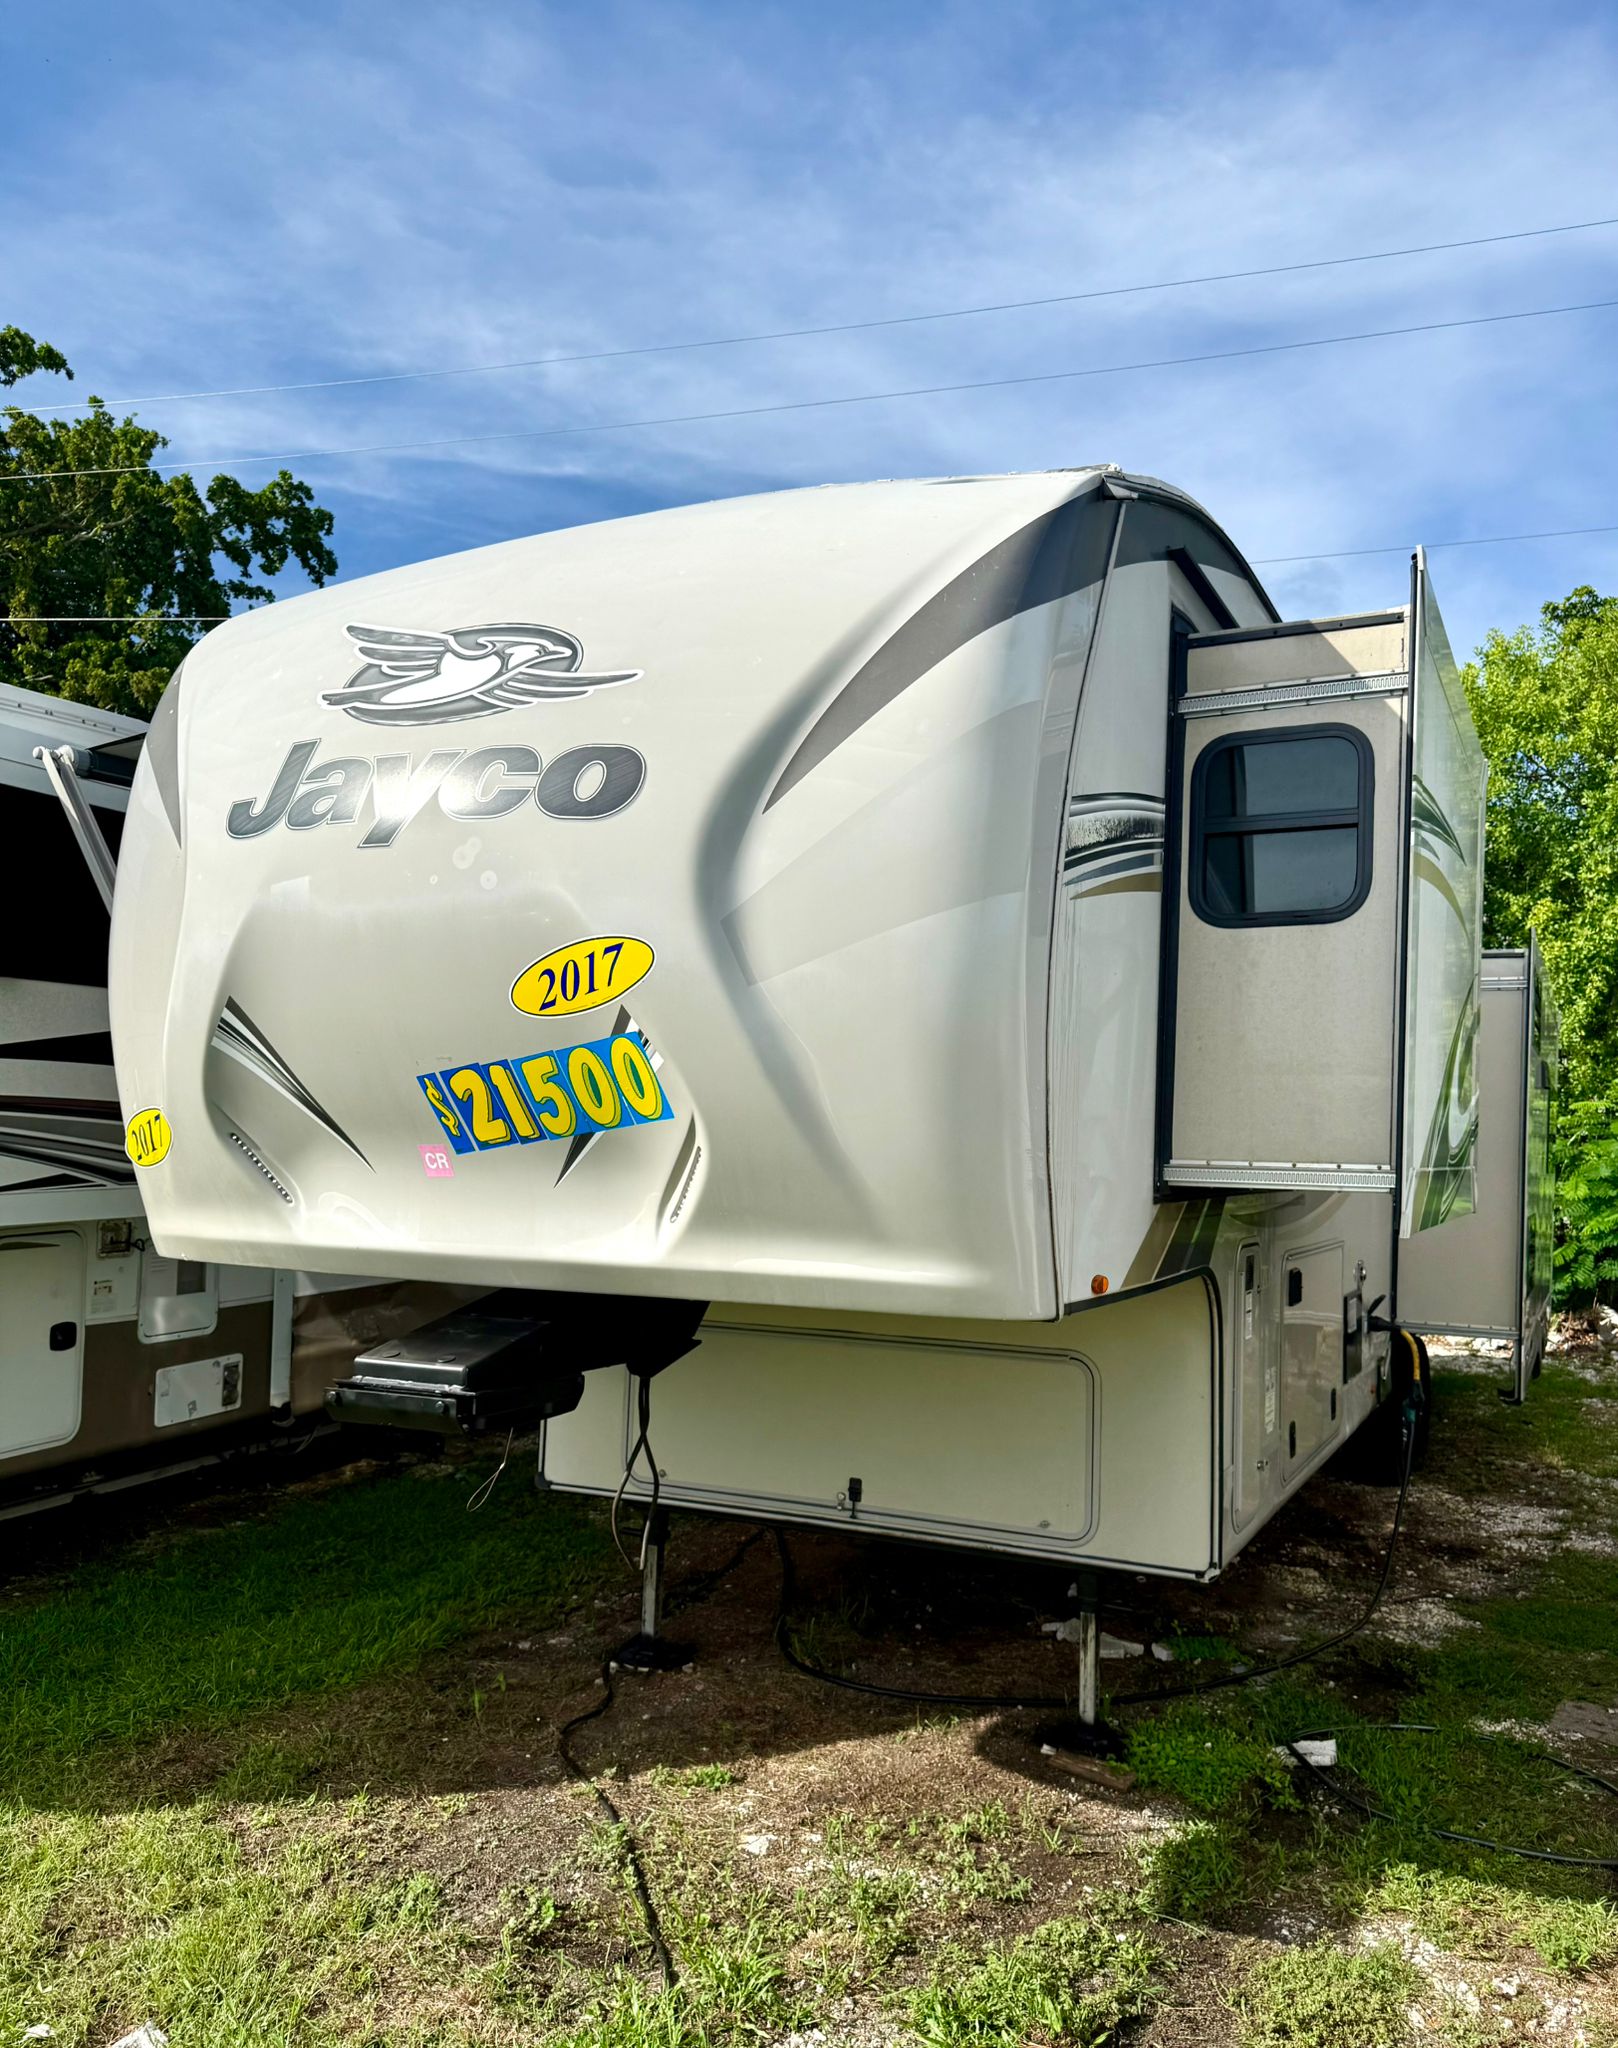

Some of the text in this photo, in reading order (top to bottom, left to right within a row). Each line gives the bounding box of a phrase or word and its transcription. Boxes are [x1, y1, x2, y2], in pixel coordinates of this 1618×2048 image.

[225, 737, 647, 848] Jayco
[537, 941, 625, 1012] 2017
[424, 1037, 663, 1144] $21500
[132, 1114, 163, 1161] 2017
[425, 1152, 449, 1169] CR
